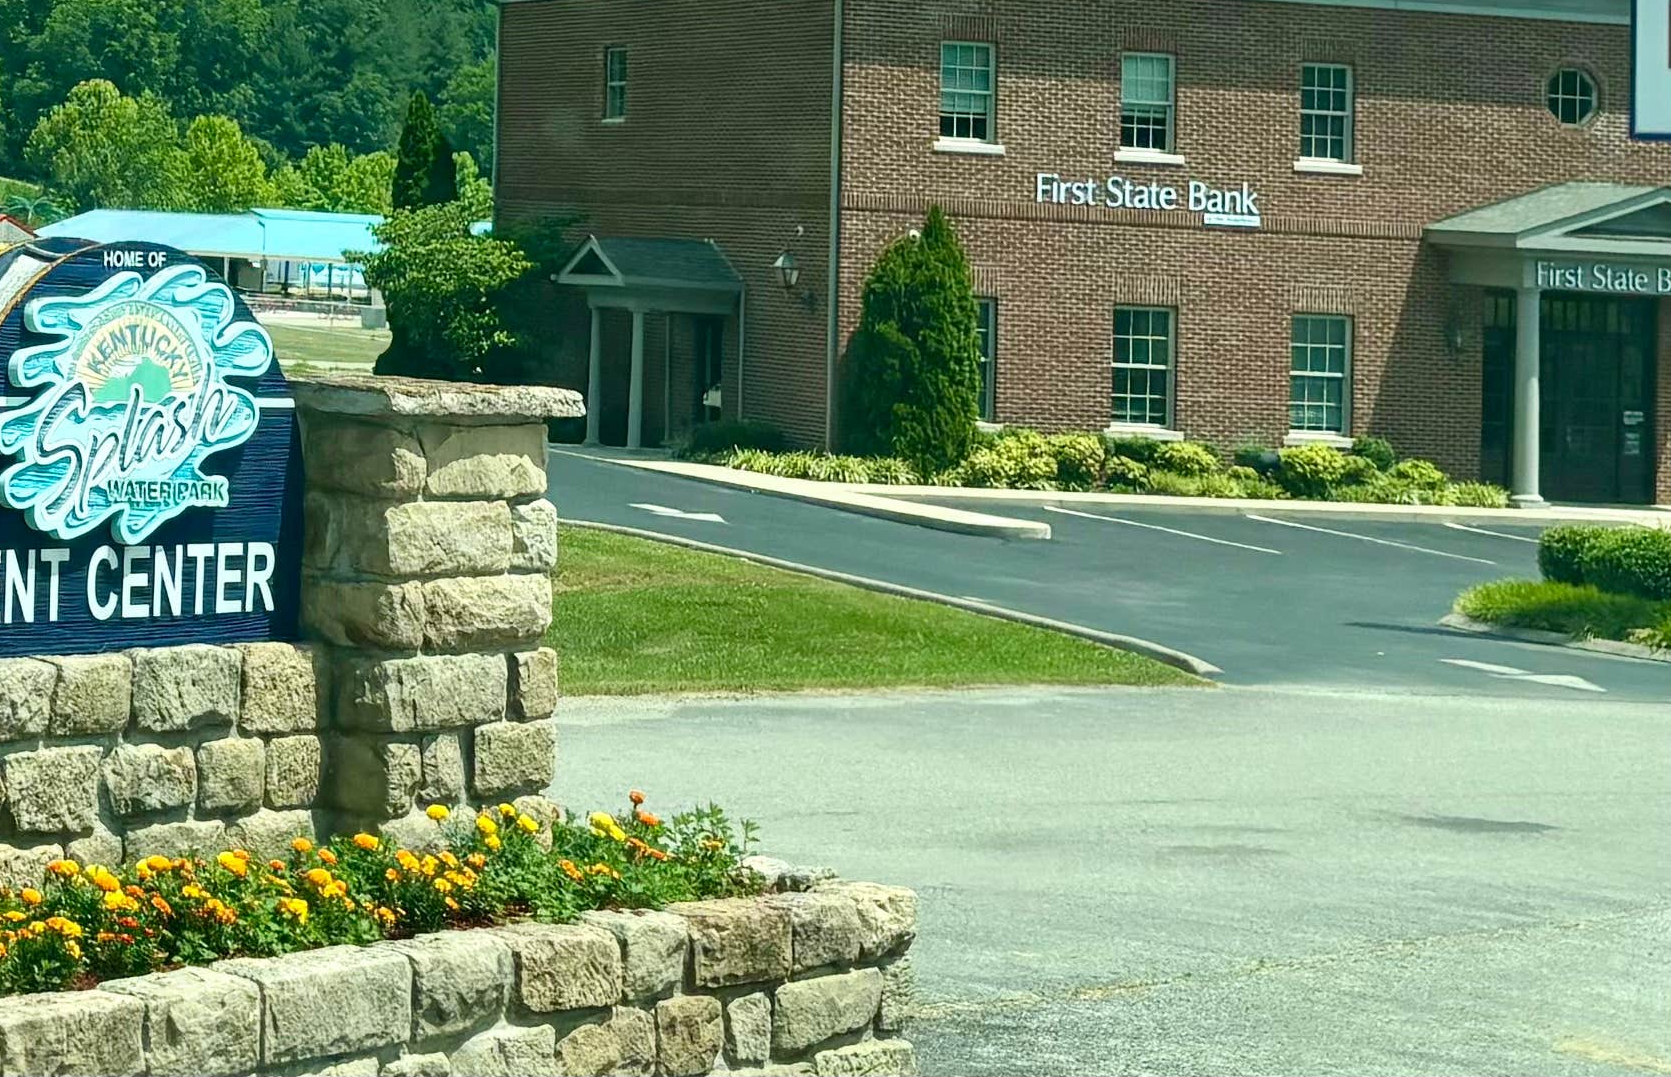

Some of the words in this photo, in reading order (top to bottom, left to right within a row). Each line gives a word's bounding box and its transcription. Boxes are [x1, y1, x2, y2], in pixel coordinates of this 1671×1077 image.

[1035, 172, 1098, 206] First
[1106, 176, 1178, 210] State
[1188, 180, 1261, 215] Bank
[103, 250, 144, 268] HOME
[148, 250, 167, 268] OF
[1536, 260, 1584, 289] First
[1591, 264, 1649, 293] State
[86, 324, 190, 380] KENTUCKY
[36, 361, 237, 515] Splash
[86, 541, 276, 622] CENTER
